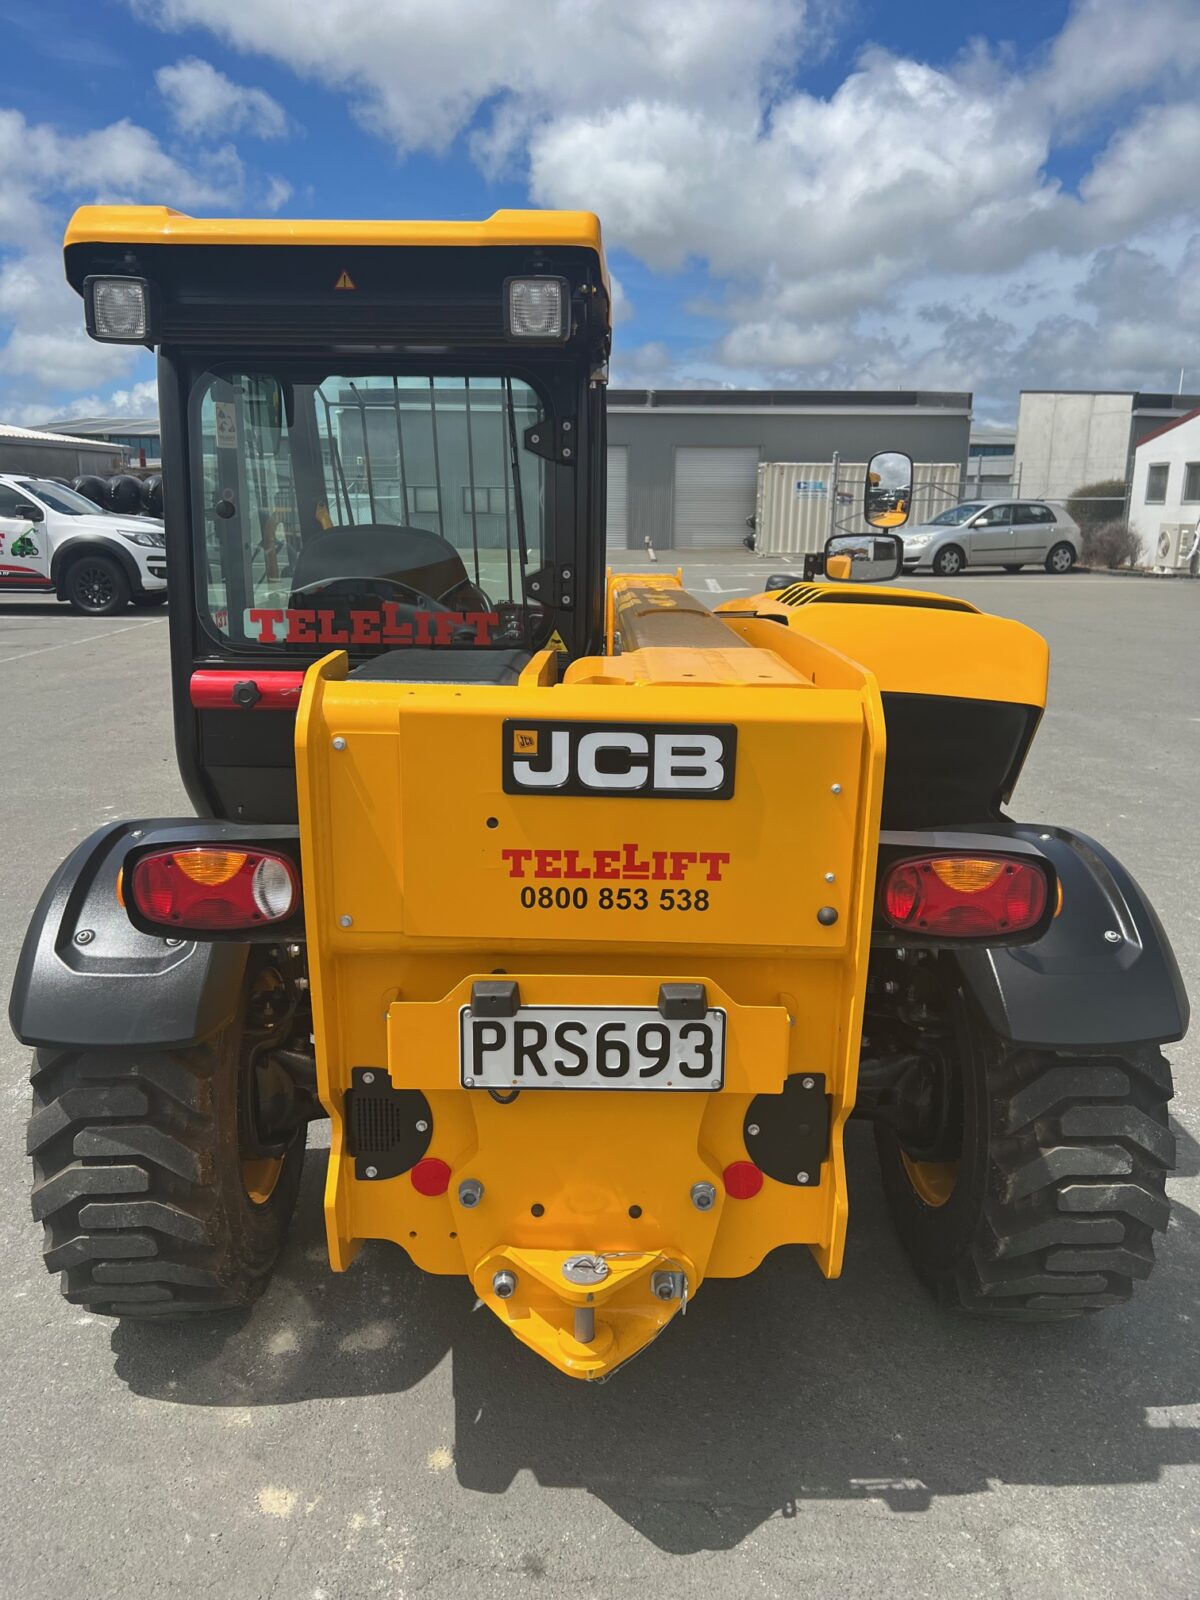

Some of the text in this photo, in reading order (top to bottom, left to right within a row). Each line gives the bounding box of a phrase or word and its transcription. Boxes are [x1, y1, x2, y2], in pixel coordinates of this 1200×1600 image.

[250, 601, 499, 646] TELELIFT
[513, 731, 725, 792] JCB
[502, 843, 730, 881] TELELIFT
[520, 887, 710, 912] 0800 853 538
[472, 1020, 713, 1078] PRS693
